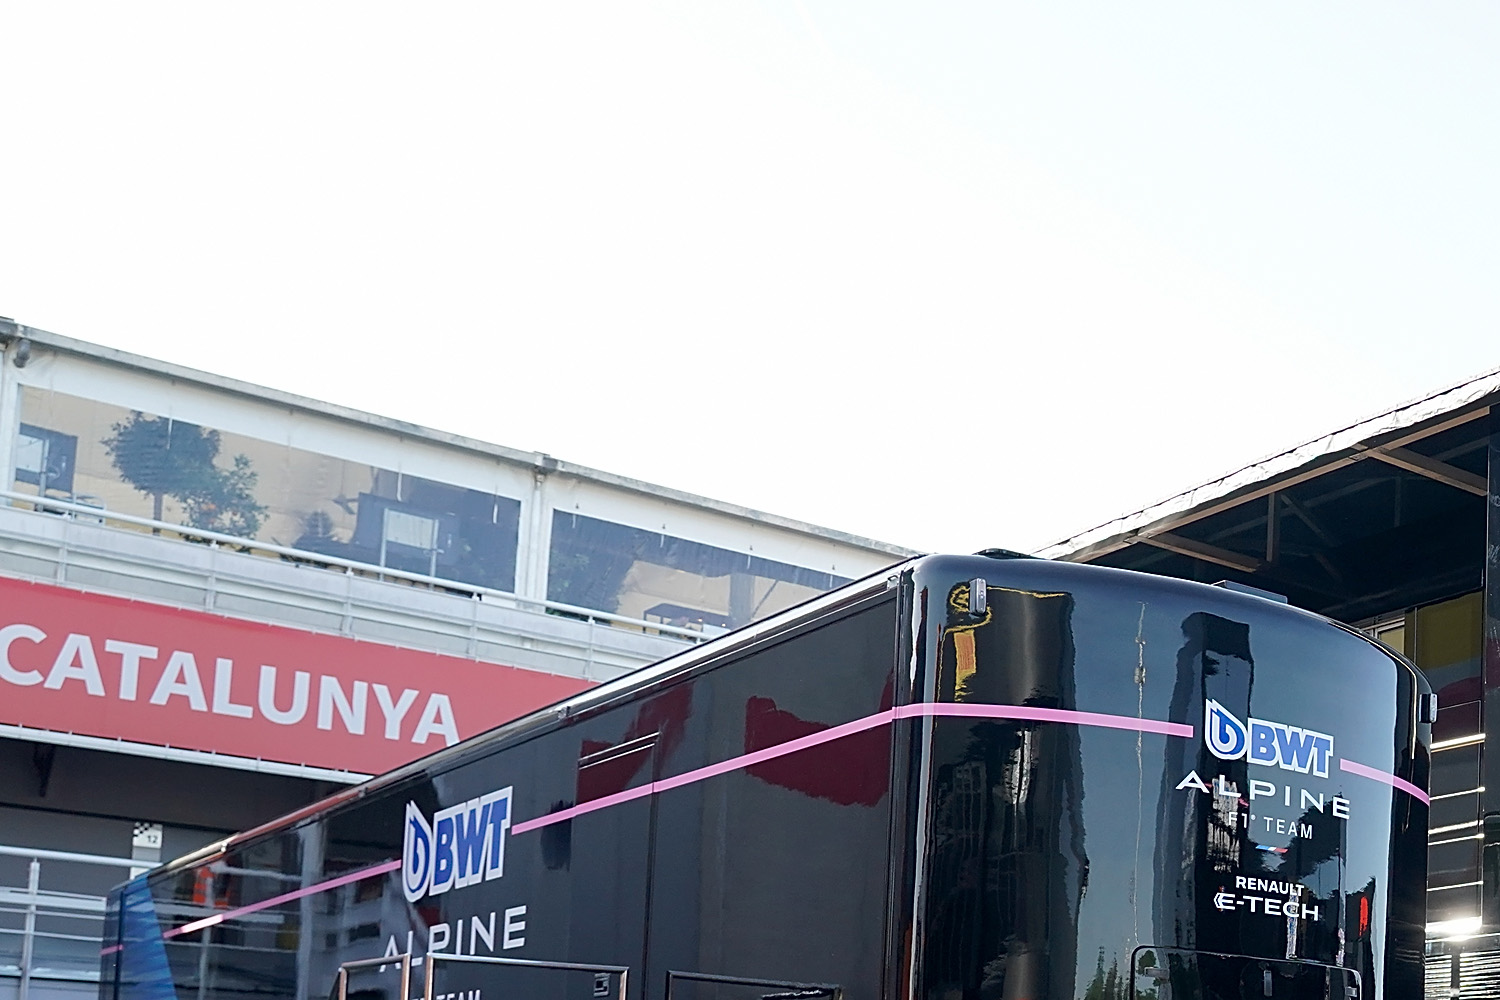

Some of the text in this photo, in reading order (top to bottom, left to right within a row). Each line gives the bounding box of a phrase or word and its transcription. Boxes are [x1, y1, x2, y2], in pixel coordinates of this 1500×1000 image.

[0, 624, 460, 747] CATALUNYA
[1247, 717, 1334, 778] BWT
[1175, 770, 1350, 819] ALPINE
[429, 786, 513, 897] BWT
[1264, 817, 1313, 840] TEAM
[1214, 892, 1319, 921] E-TECH
[1235, 876, 1304, 897] RENAULT
[379, 905, 527, 973] ALPINE
